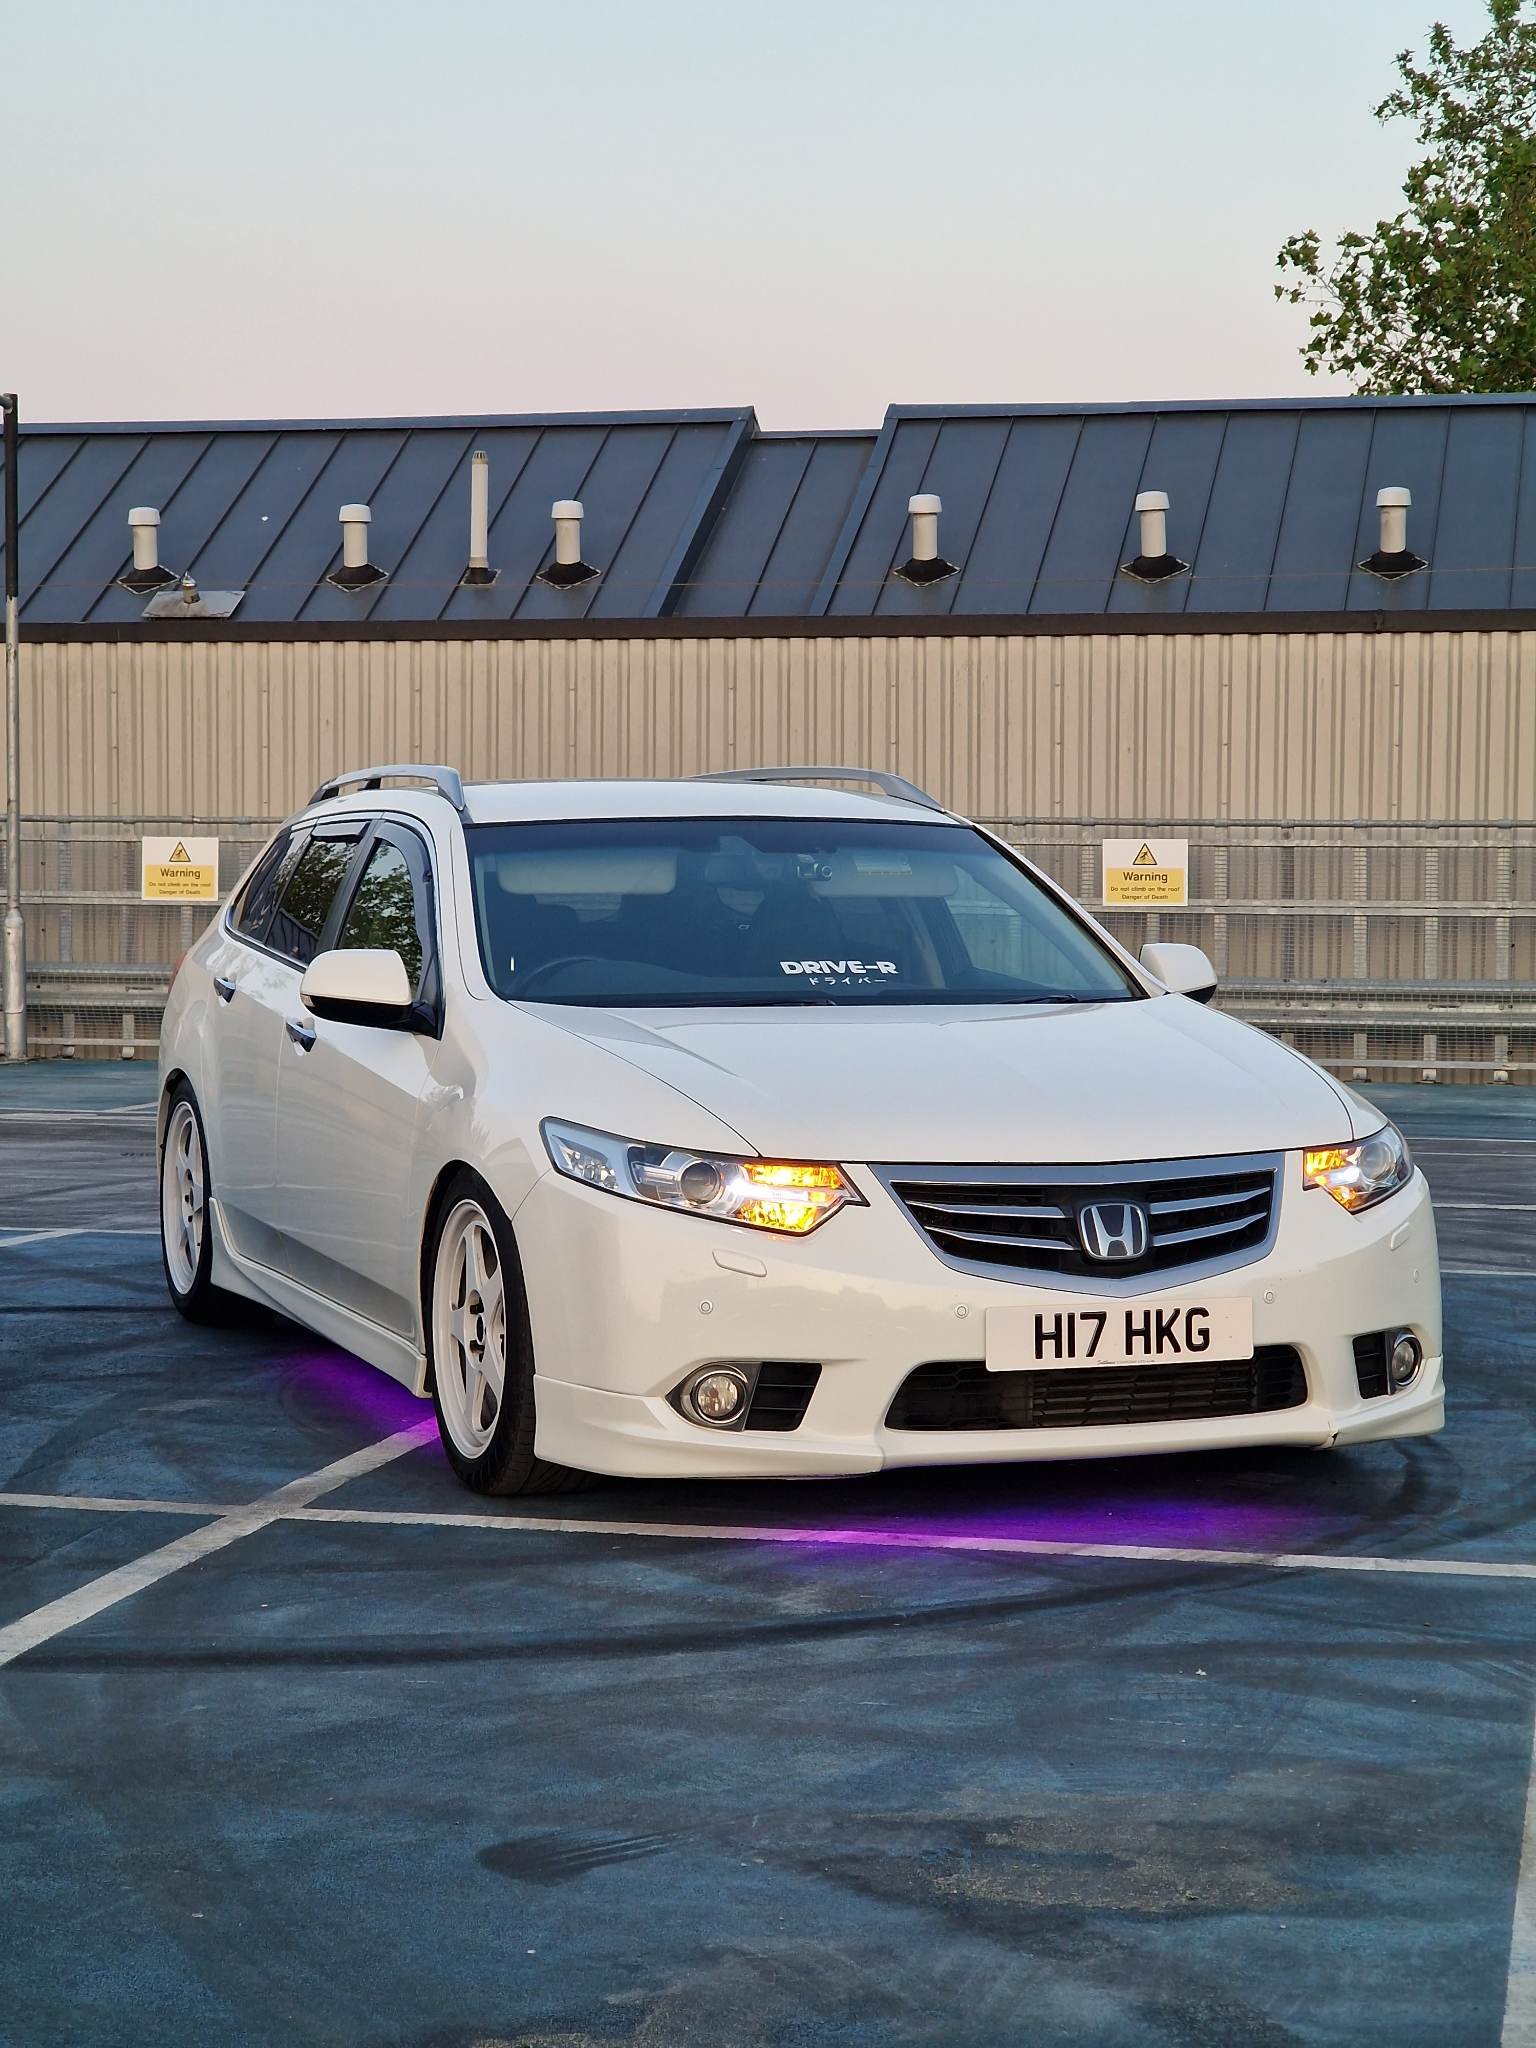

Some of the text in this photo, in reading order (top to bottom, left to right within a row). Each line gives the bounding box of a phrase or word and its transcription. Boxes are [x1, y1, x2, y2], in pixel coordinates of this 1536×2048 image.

[160, 868, 201, 880] Warning
[1123, 872, 1168, 884] Warning
[780, 960, 899, 975] DRIVE-R
[808, 976, 887, 986] ドライバー
[1125, 1307, 1210, 1355] HKG
